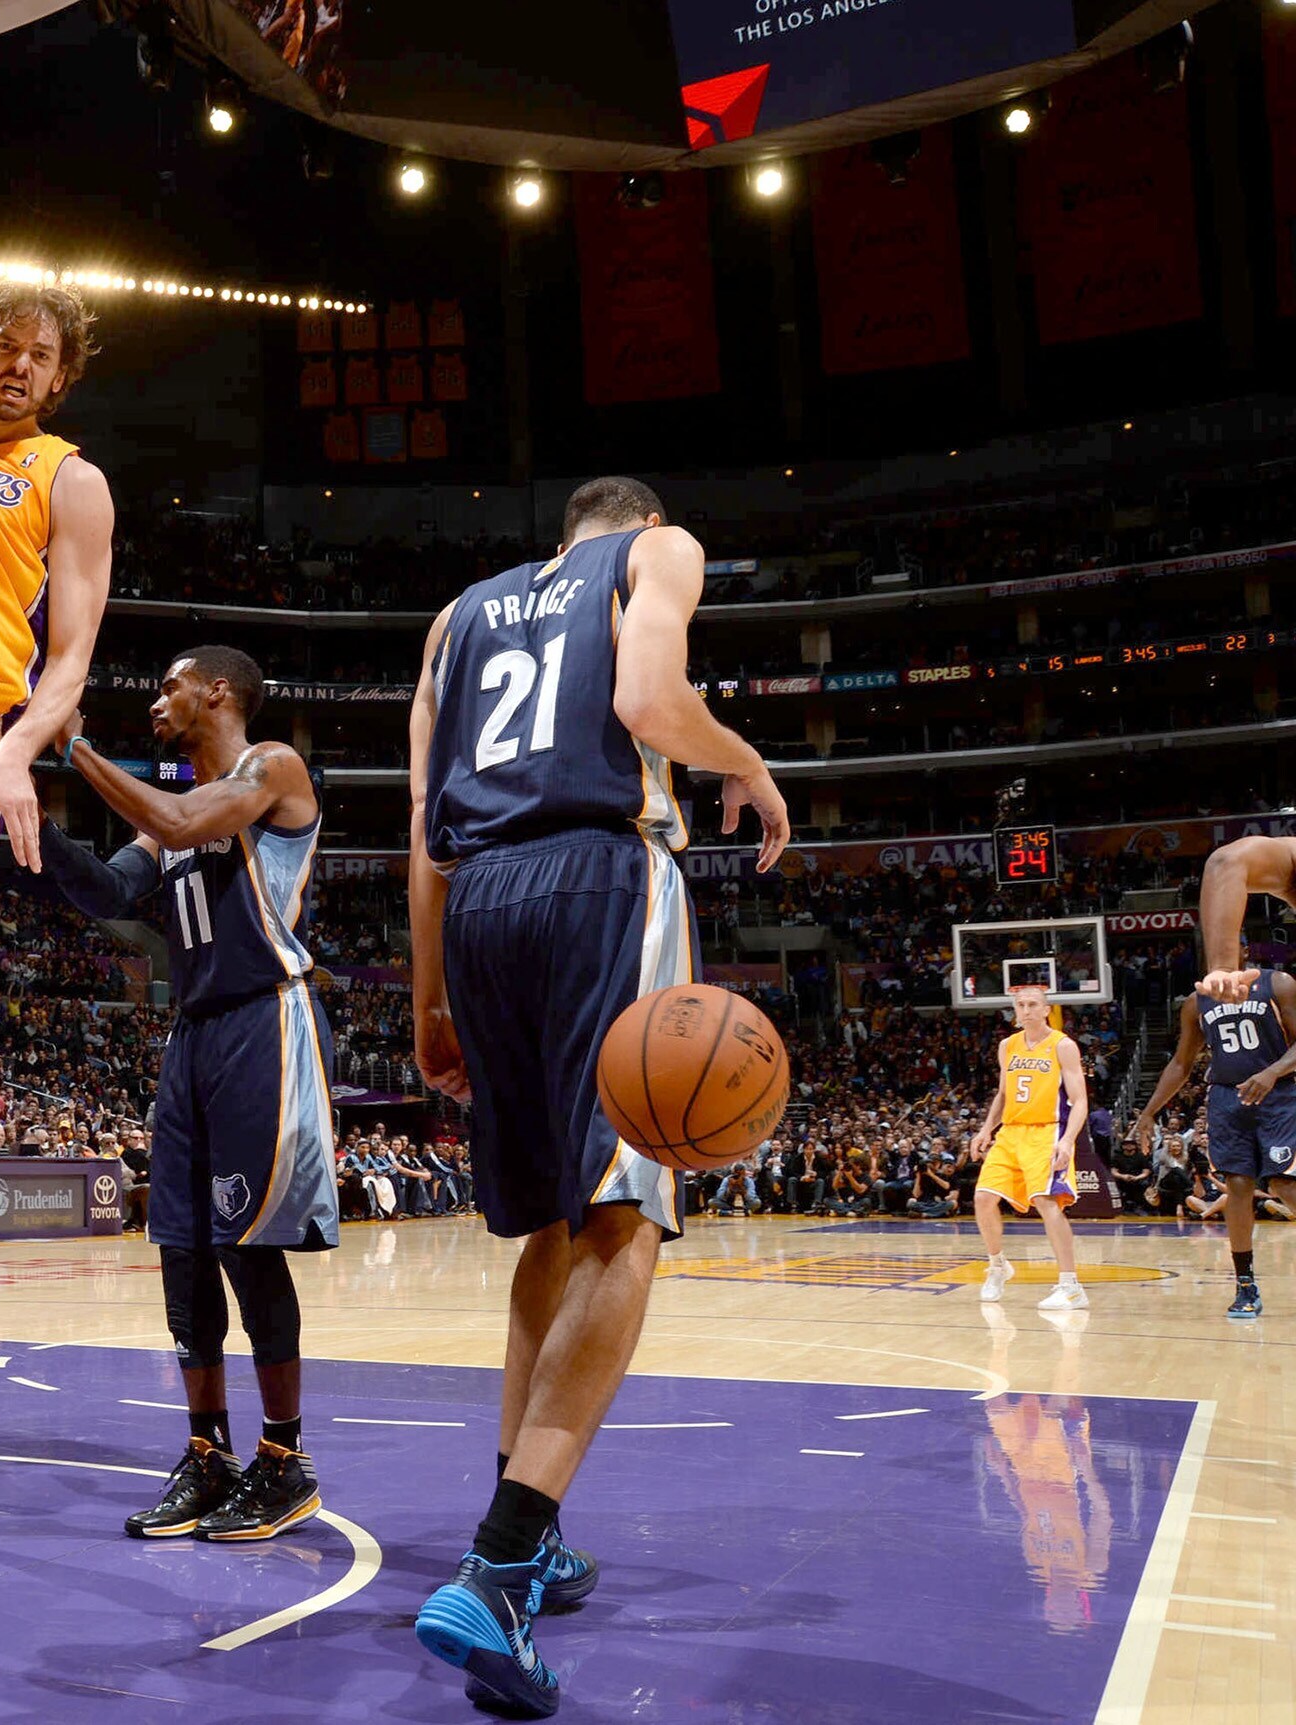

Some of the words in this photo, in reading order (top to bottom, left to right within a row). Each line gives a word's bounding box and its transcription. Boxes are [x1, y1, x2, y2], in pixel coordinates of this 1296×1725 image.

[733, 20, 772, 45] THE
[778, 8, 814, 32] LOS
[483, 579, 585, 630] PRINCE
[1225, 634, 1248, 651] 22
[112, 676, 159, 690] PANI
[843, 673, 898, 688] DELTA
[907, 665, 972, 683] STAPLES
[718, 679, 739, 690] MEM
[269, 686, 335, 700] PANINI
[335, 686, 414, 702] Authentic
[475, 632, 566, 773] 21
[159, 762, 178, 771] BOS
[159, 771, 178, 780] OTT
[1013, 831, 1051, 849] 3:45
[1008, 849, 1048, 877] 24
[175, 870, 213, 950] 11
[1107, 912, 1196, 932] TOYOTA
[1218, 1019, 1260, 1053] 50
[1007, 1054, 1053, 1073] LAKERS
[1015, 1075, 1032, 1103] 5
[13, 1189, 74, 1210] Prudential
[89, 1207, 121, 1219] TOYOTA
